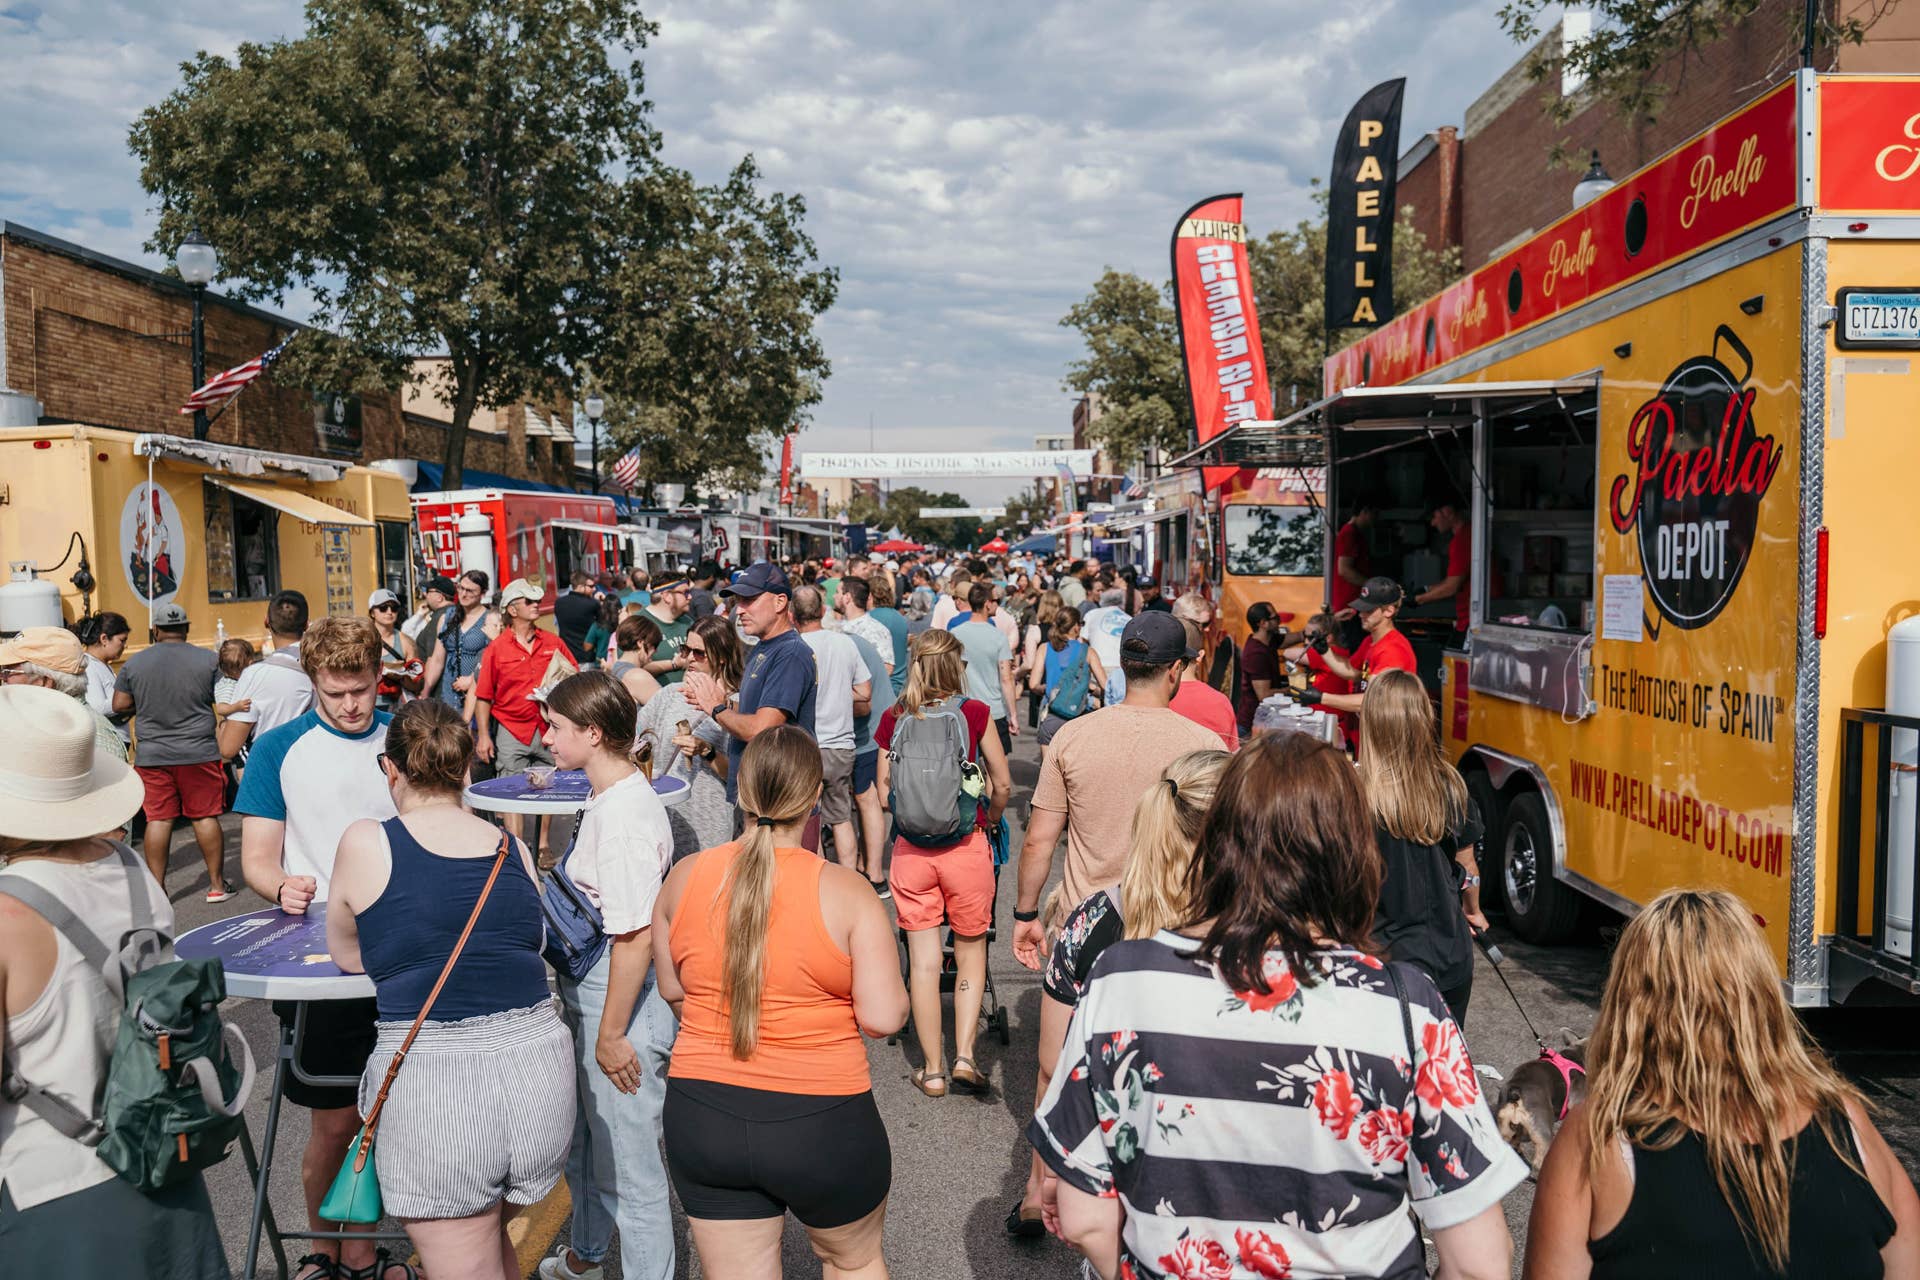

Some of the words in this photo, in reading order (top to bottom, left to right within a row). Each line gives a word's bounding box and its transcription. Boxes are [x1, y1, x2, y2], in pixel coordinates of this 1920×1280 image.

[1352, 119, 1384, 323] PAELLA
[1680, 133, 1768, 230] Paella
[1543, 227, 1599, 298] Paella
[1450, 287, 1490, 342] Paella
[1851, 306, 1918, 329] CTZ1376
[1610, 387, 1783, 535] Paella
[1657, 519, 1730, 581] DEPOT
[1602, 664, 1627, 710] THE
[1629, 668, 1688, 724] HOTDISH
[1692, 683, 1713, 729] OF
[1719, 681, 1775, 744] SPAIN
[1569, 758, 1784, 878] WWW.PAELLADEPOT.COM
